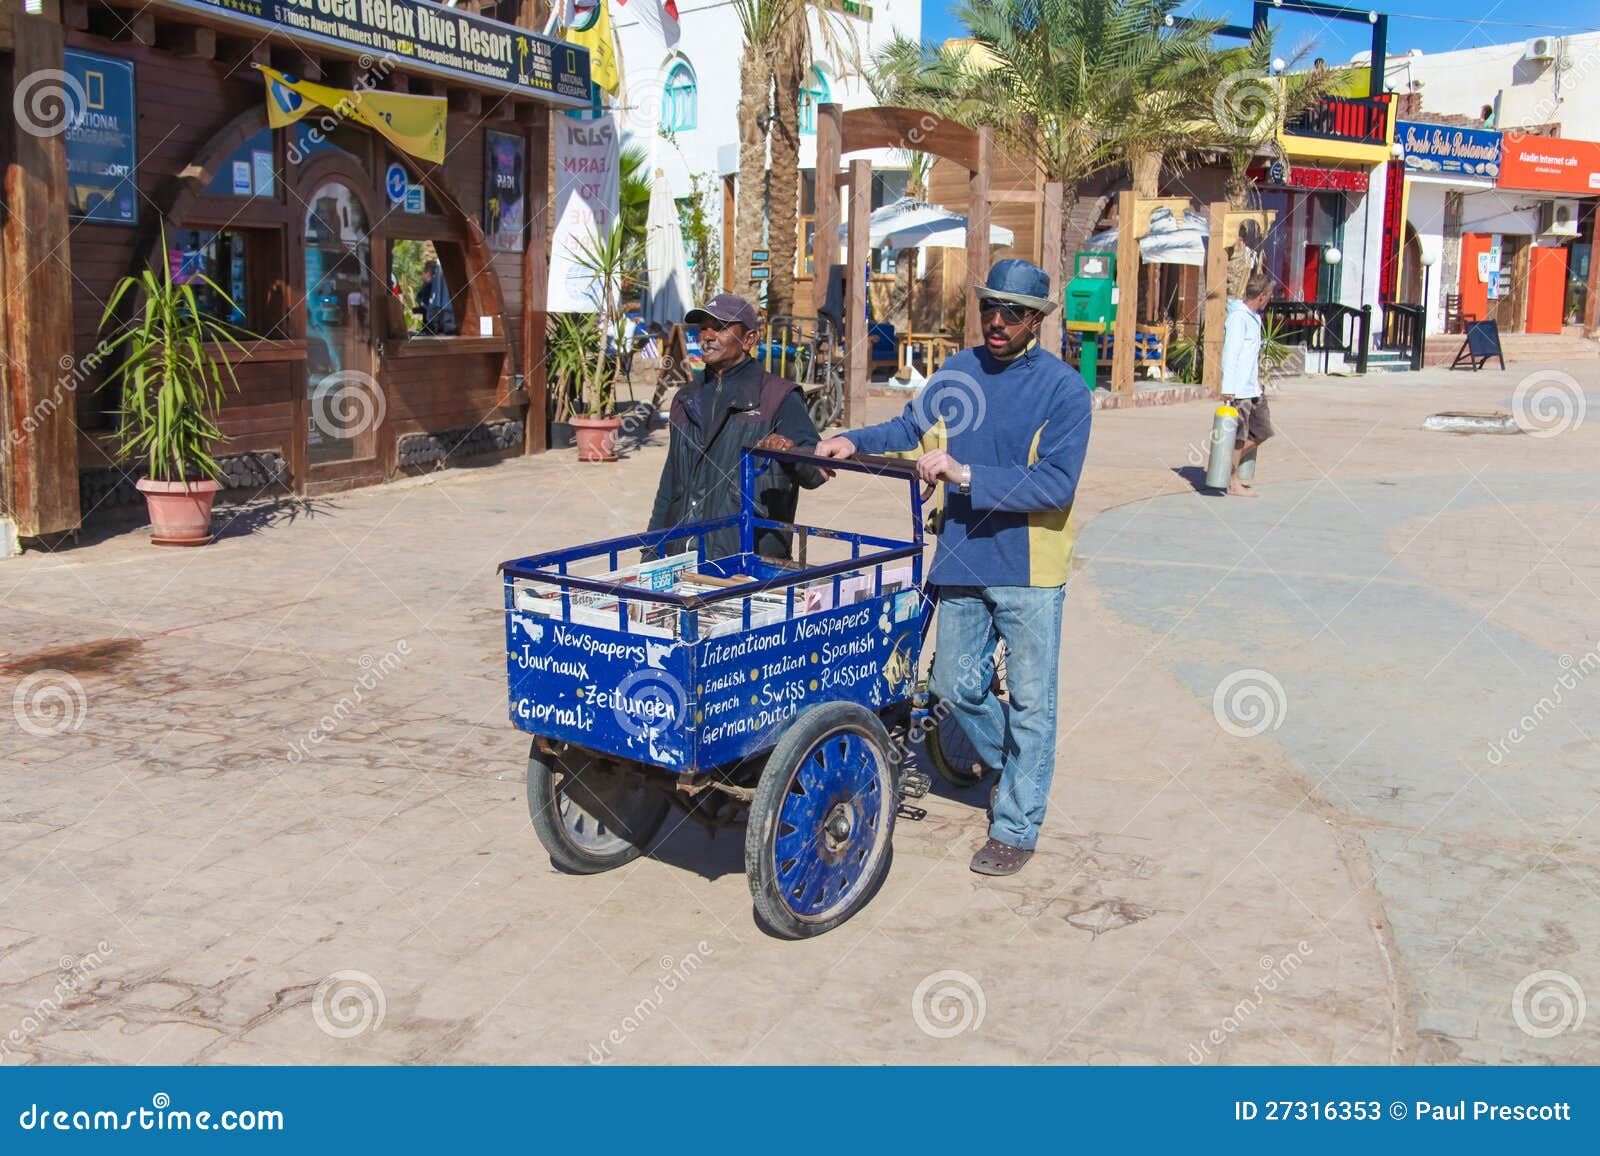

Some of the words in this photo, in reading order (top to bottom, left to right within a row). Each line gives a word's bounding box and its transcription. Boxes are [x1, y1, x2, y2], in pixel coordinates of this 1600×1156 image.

[274, 4, 282, 20] 5
[283, 8, 310, 29] Times
[310, 15, 337, 36] Award
[338, 23, 372, 44] Winners
[382, 33, 396, 51] The
[361, 0, 416, 38] Relax
[417, 6, 456, 49] Dive
[459, 18, 514, 64] Resort
[70, 112, 119, 131] NATIONAL
[1519, 151, 1539, 163] Aladin
[1539, 154, 1564, 166] Internet
[553, 625, 645, 664] Newspapers
[701, 626, 786, 668] Intenational
[793, 608, 870, 642] Newspapers
[762, 654, 806, 680] Italian
[821, 633, 875, 664] Spanish
[518, 644, 590, 680] Journaux
[585, 684, 676, 723] Zeitungen
[705, 696, 739, 720] French
[760, 680, 806, 706] Swiss
[821, 660, 877, 691] Russian
[703, 715, 755, 745] German
[759, 699, 797, 728] Dutch
